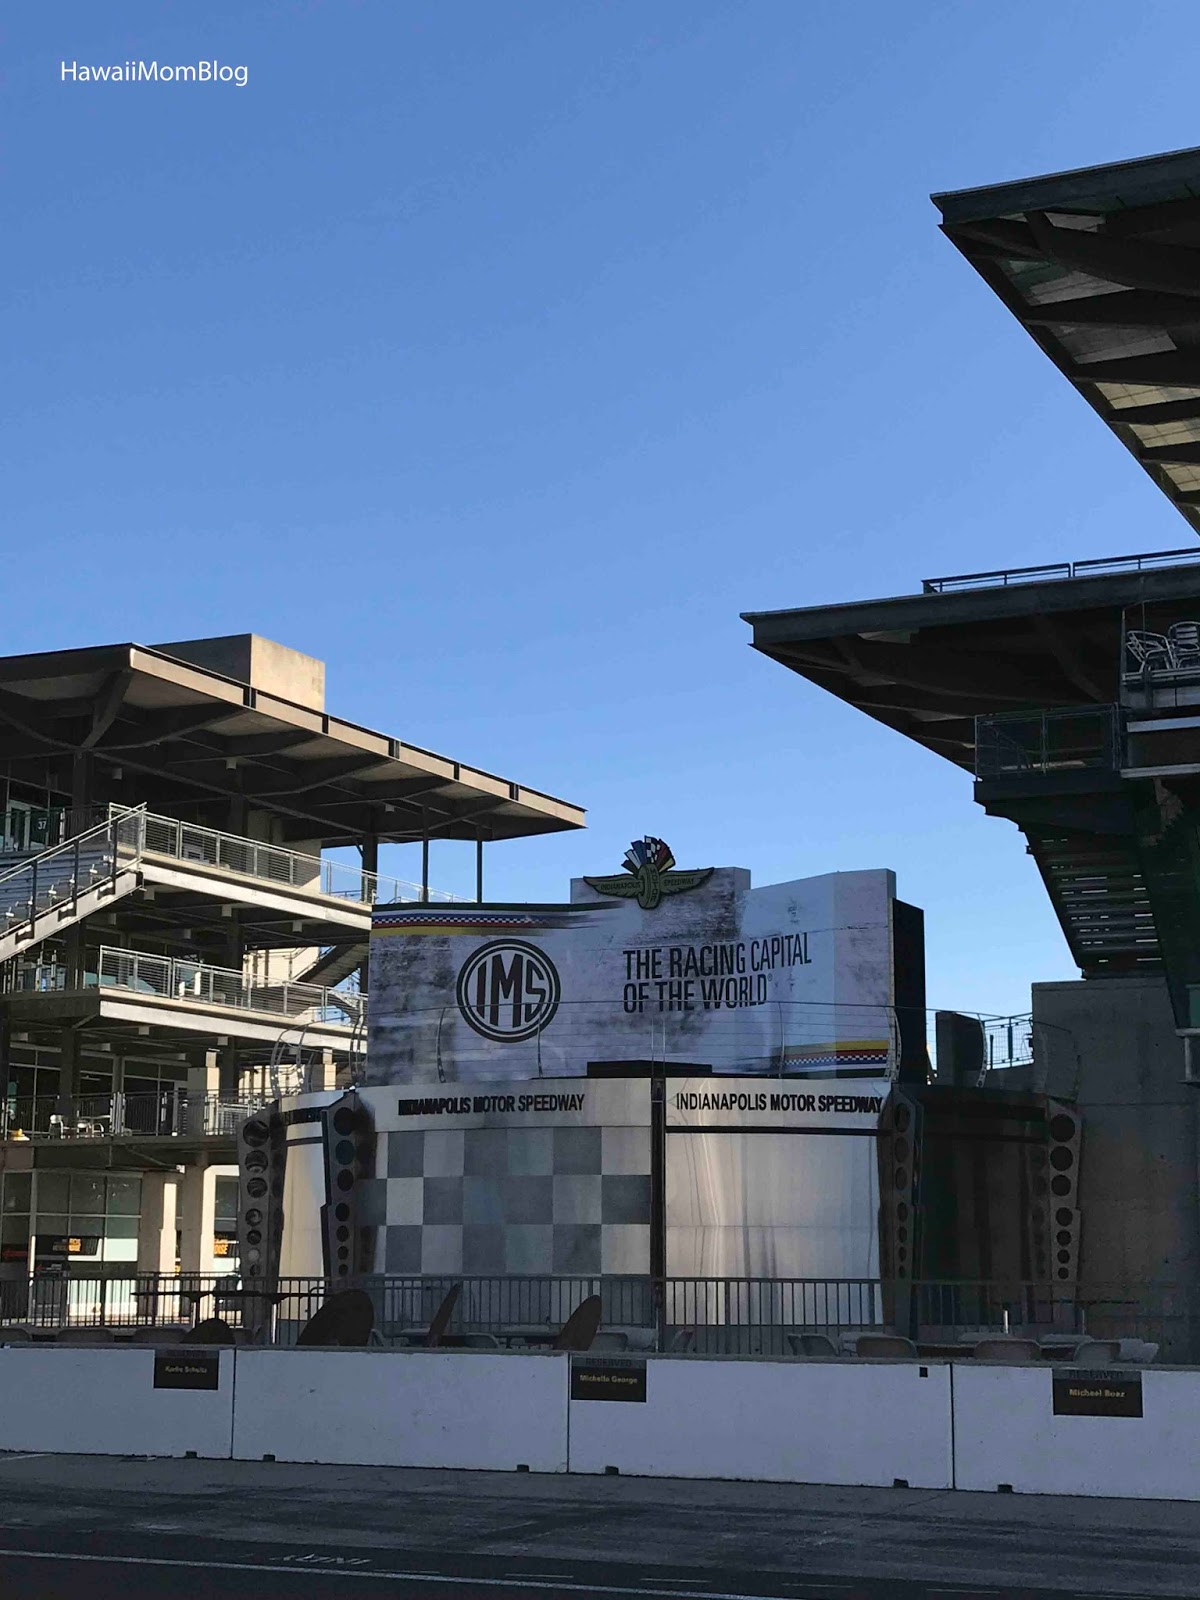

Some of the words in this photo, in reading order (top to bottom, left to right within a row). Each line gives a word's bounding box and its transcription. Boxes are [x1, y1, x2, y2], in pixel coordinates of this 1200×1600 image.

[650, 869, 659, 901] MOTOR
[623, 949, 663, 980] THE
[669, 943, 746, 978] RACING
[751, 932, 812, 972] CAPITAL
[476, 953, 547, 1029] IMS
[623, 982, 650, 1014] OF
[655, 980, 695, 1012] THE
[473, 1095, 516, 1114] MOTOR
[518, 1093, 586, 1112] SPEEDWAY
[676, 1092, 767, 1111] INDIANAPOLIS
[769, 1093, 816, 1112] MOTOR
[817, 1094, 884, 1114] SPEEDWAY
[611, 1375, 638, 1384] George
